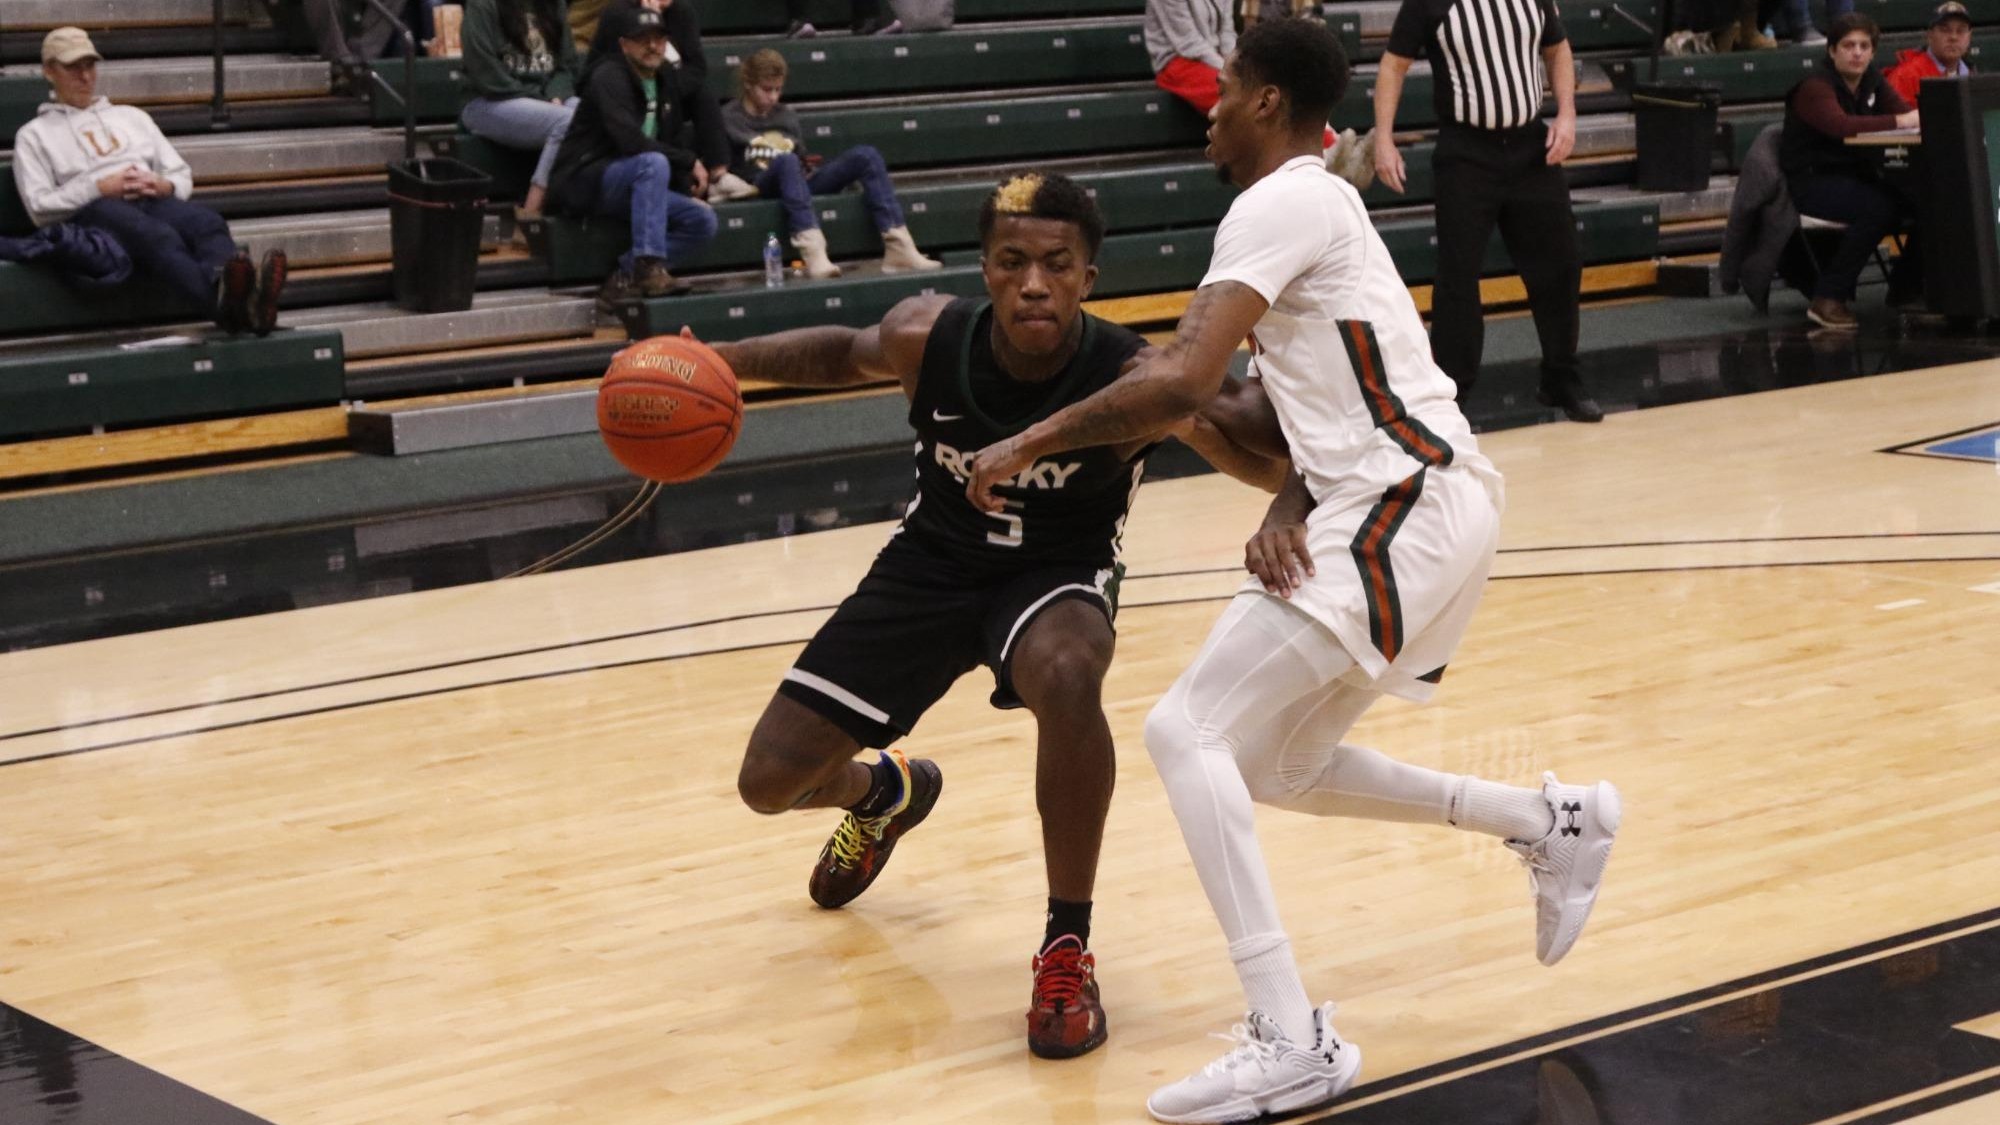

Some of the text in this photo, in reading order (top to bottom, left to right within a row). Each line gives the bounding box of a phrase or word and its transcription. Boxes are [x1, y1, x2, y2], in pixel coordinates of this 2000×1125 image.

[81, 130, 121, 157] U
[934, 442, 1082, 490] ROKY
[985, 500, 1024, 547] 5
